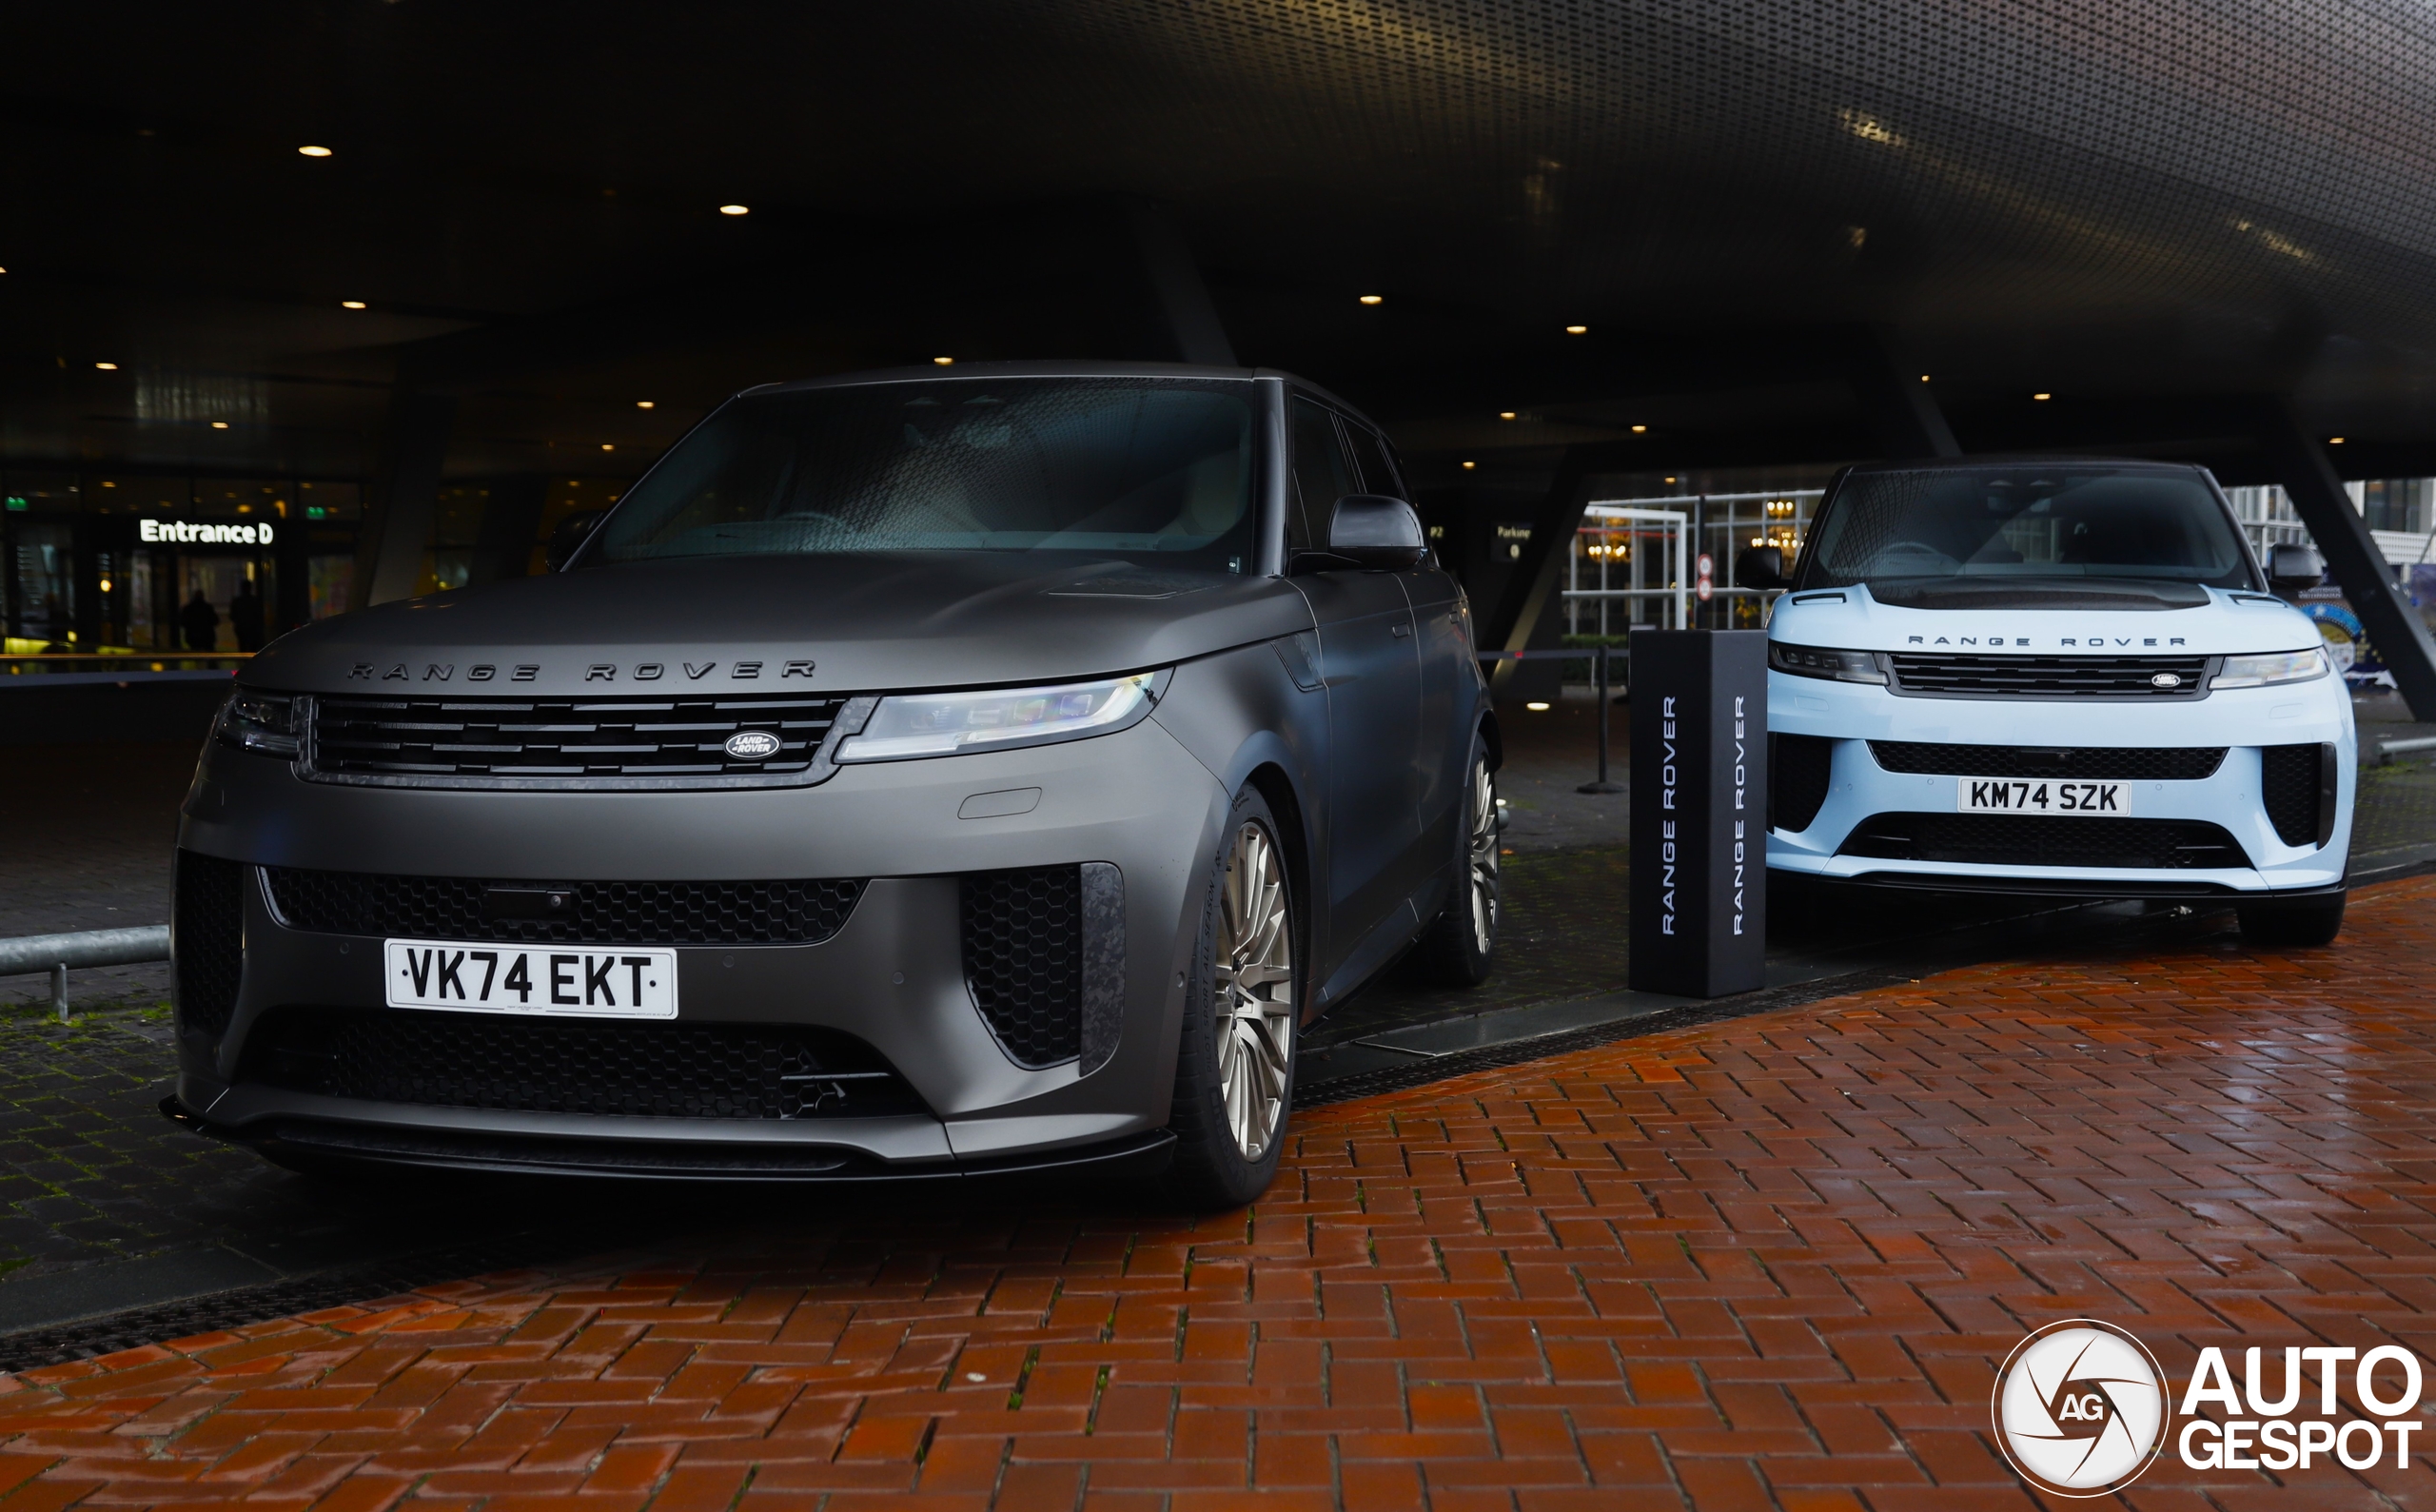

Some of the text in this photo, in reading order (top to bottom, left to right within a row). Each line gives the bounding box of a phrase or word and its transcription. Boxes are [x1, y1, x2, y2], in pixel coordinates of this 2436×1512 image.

[140, 519, 274, 545] Entrance D
[1429, 526, 1444, 539] P2
[1497, 525, 1531, 540] Parking
[1908, 636, 2187, 647] RANGE ROVER
[347, 659, 816, 682] RANGE ROVER
[735, 736, 763, 745] LAND
[737, 743, 772, 754] ROVER
[1971, 781, 2118, 811] KM74 SZK
[1662, 696, 1676, 935] RANGE ROVER
[1734, 696, 1745, 936] RANGE ROVER
[1204, 879, 1216, 938] SEASON
[406, 948, 652, 1007] VK74 EKT
[1204, 1034, 1213, 1073] PILOT
